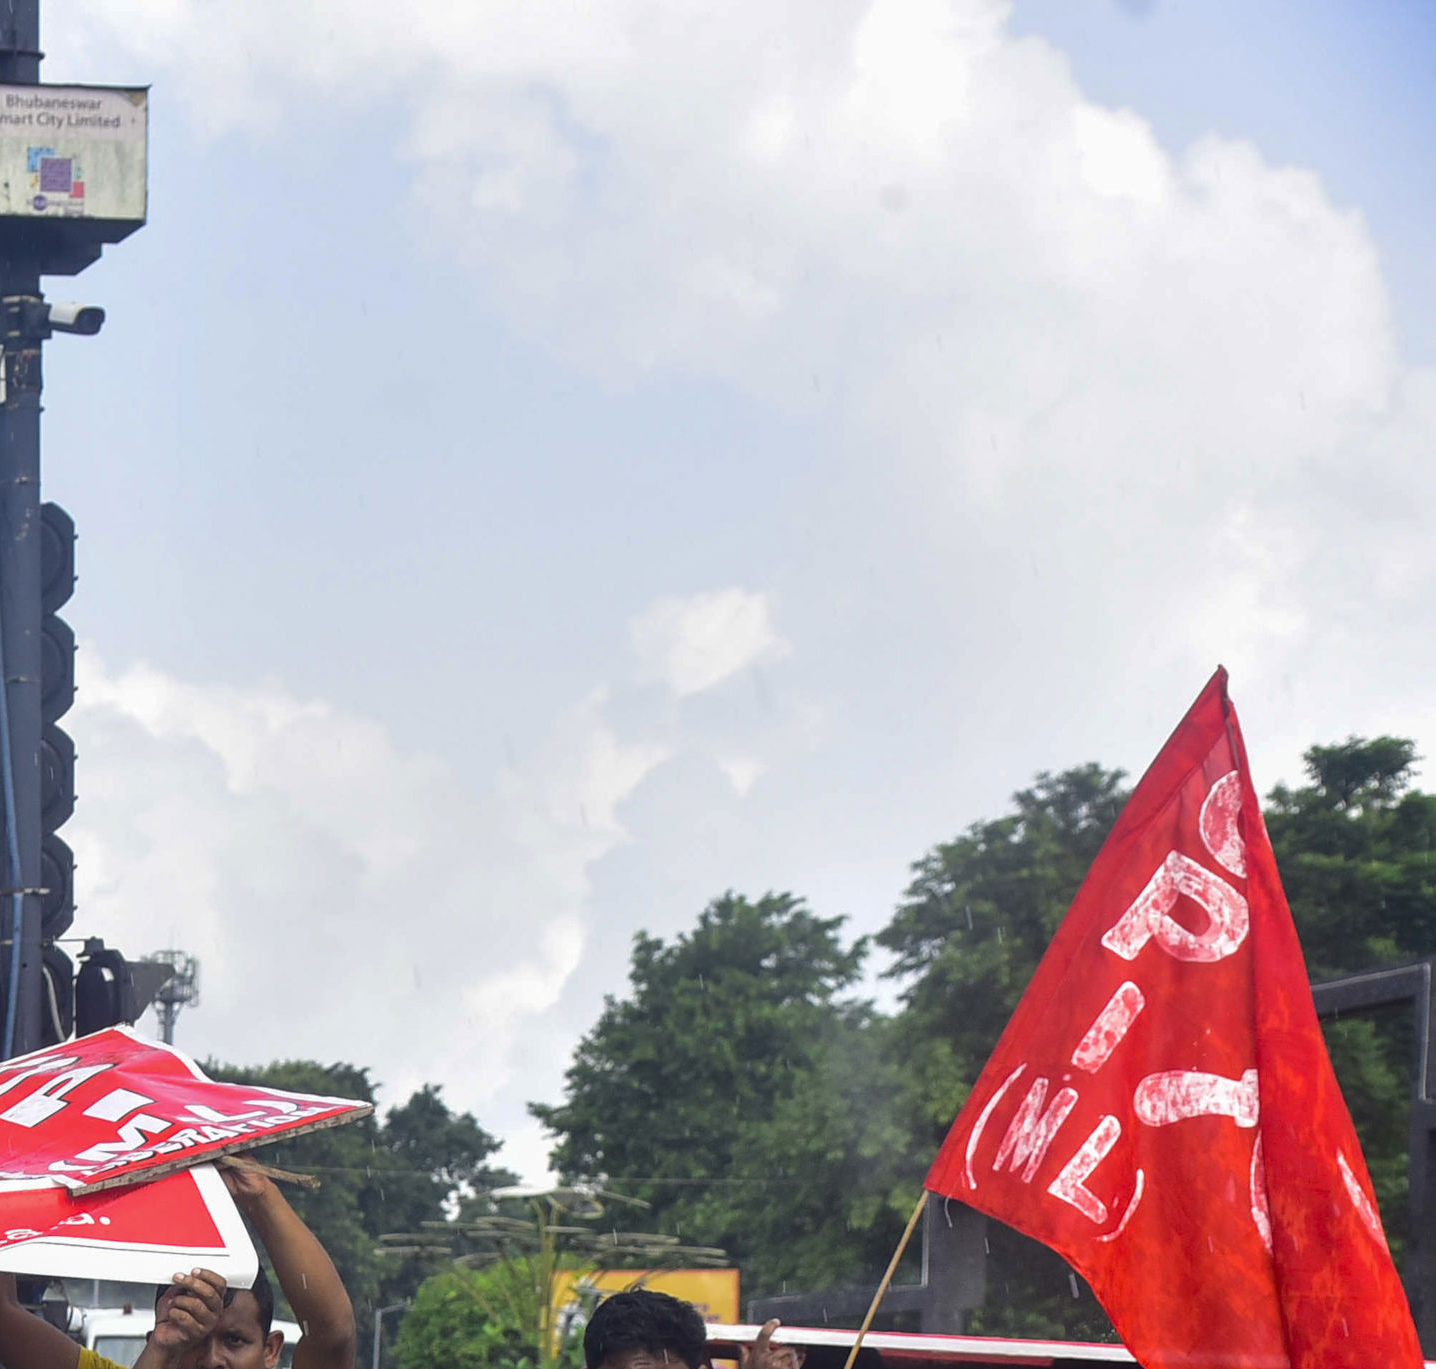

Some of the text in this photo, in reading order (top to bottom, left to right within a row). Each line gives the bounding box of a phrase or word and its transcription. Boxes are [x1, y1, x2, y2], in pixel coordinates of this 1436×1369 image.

[6, 94, 102, 110] Bhubaneswar
[36, 112, 63, 129] City
[67, 114, 121, 129] Limited
